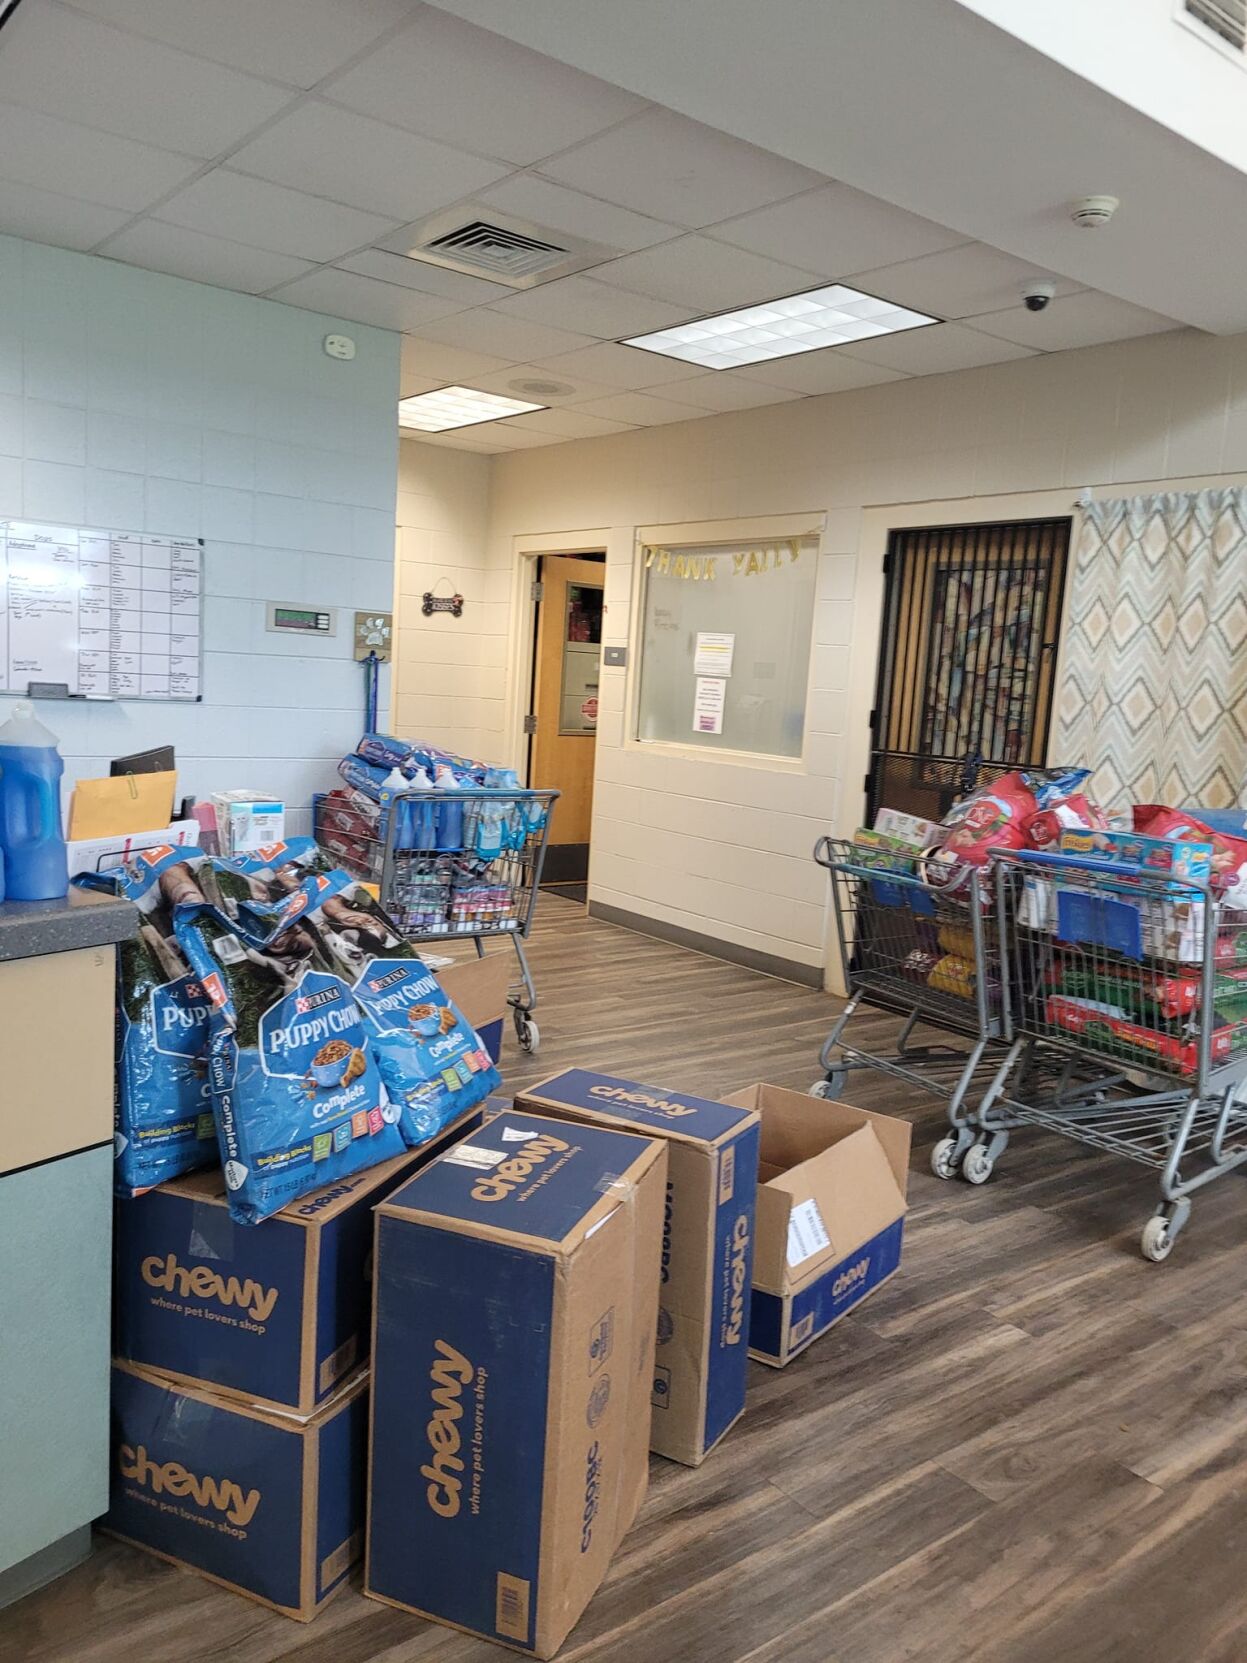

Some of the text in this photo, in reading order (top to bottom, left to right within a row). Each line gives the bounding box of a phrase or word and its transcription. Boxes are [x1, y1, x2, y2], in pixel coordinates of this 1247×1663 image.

[645, 546, 717, 580] THANK
[402, 975, 439, 999] CHOW
[269, 1016, 330, 1054] PUPPY
[212, 1057, 226, 1087] CHOW
[312, 1084, 366, 1119] Complete
[590, 1086, 698, 1116] chewy
[221, 1095, 238, 1157] Complete
[471, 1135, 569, 1202] chewy
[515, 1183, 541, 1202] where
[537, 1173, 549, 1185] pet
[545, 1157, 565, 1175] lovers
[141, 1253, 279, 1321] chewy
[726, 1215, 749, 1345] chewy
[832, 1257, 870, 1296] chewy
[150, 1297, 266, 1335] where pet lovers shop
[420, 1339, 474, 1518] chewy
[468, 1366, 488, 1515] where pet lovers shop
[121, 1444, 260, 1526] chewy
[160, 1502, 179, 1515] pet
[180, 1508, 215, 1528] lovers
[217, 1522, 248, 1540] shop
